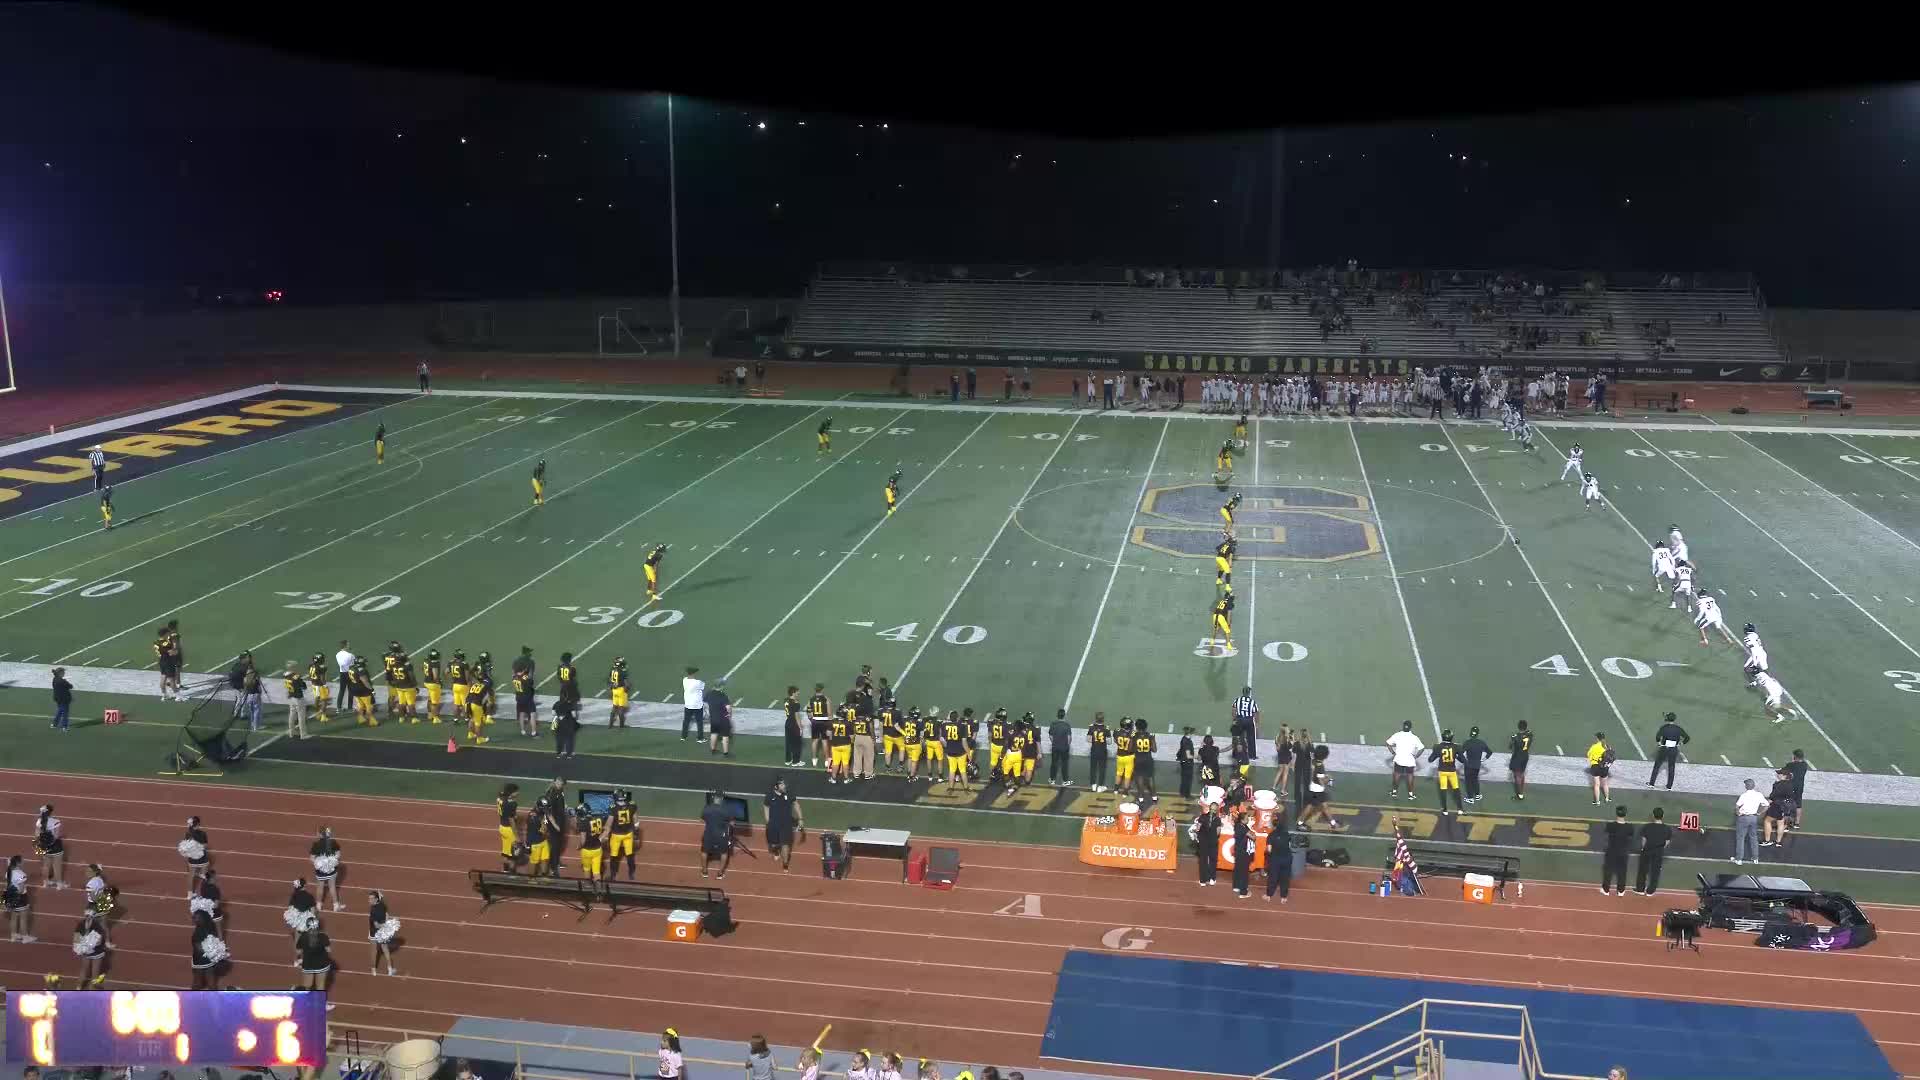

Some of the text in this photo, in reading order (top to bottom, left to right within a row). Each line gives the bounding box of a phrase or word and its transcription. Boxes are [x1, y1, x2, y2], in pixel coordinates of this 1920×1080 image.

[105, 711, 118, 723] 20
[1683, 815, 1698, 829] 40
[1091, 844, 1167, 861] GATORADE
[1101, 926, 1155, 950] G
